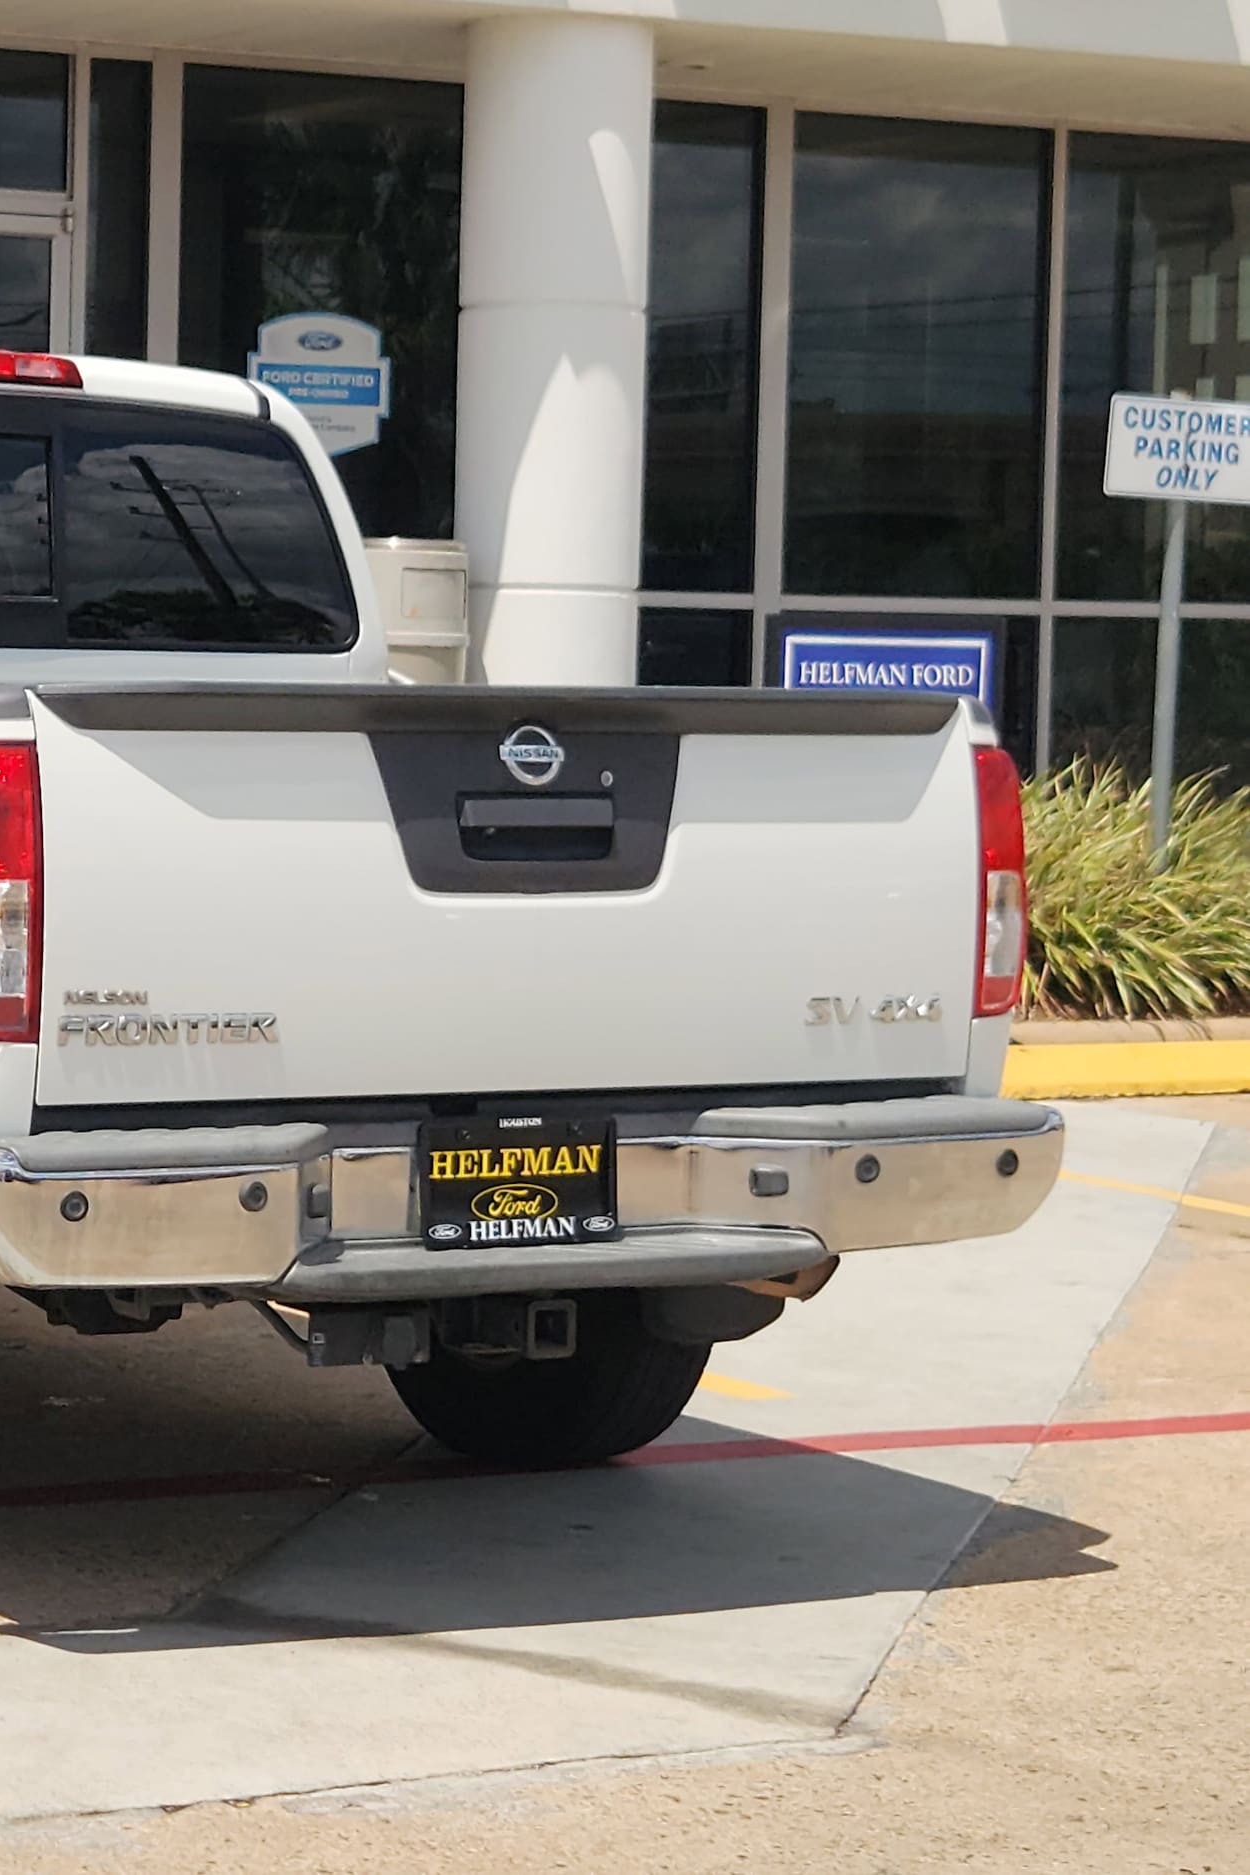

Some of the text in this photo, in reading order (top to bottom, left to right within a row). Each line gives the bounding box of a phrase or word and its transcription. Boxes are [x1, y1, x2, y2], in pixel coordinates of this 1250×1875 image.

[262, 370, 374, 387] FORD CERTIFIED
[1124, 405, 1250, 437] CUSTOMER
[1135, 436, 1239, 464] PARKING
[1156, 465, 1219, 491] ONLY
[800, 661, 975, 687] HELFMAN FORD
[507, 747, 560, 759] NISSAN
[805, 996, 860, 1026] SV
[57, 1012, 280, 1047] FRONTIER
[499, 1117, 543, 1129] HOUSTON
[429, 1144, 602, 1180] HELFMAN
[487, 1187, 542, 1217] Ford
[468, 1215, 577, 1242] HELFMAN
